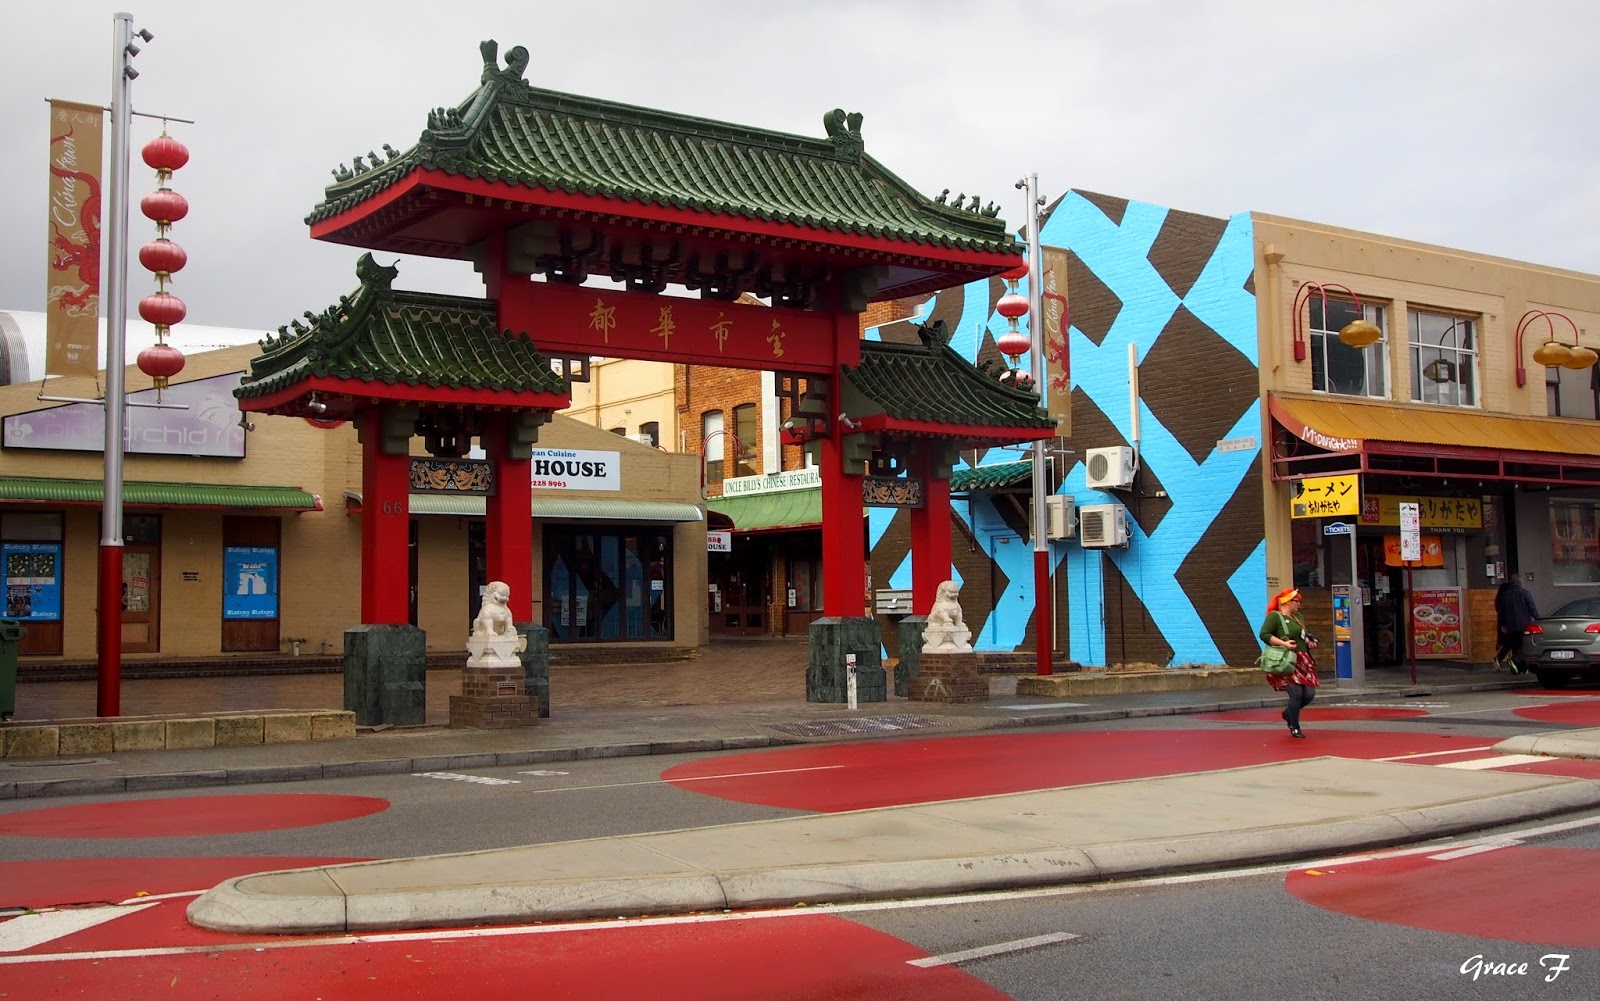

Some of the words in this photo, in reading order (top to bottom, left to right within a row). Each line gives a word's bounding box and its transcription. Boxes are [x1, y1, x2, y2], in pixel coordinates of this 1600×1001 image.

[547, 449, 577, 458] Cuisine
[534, 459, 607, 478] HOUSE
[548, 480, 567, 488] 8963
[725, 481, 742, 494] UNCLE
[743, 477, 761, 492] BILLY'S
[763, 474, 787, 490] CHINESE
[789, 471, 821, 487] RESTAURA
[1329, 525, 1352, 533] TICKETS
[707, 536, 722, 544] BBQ
